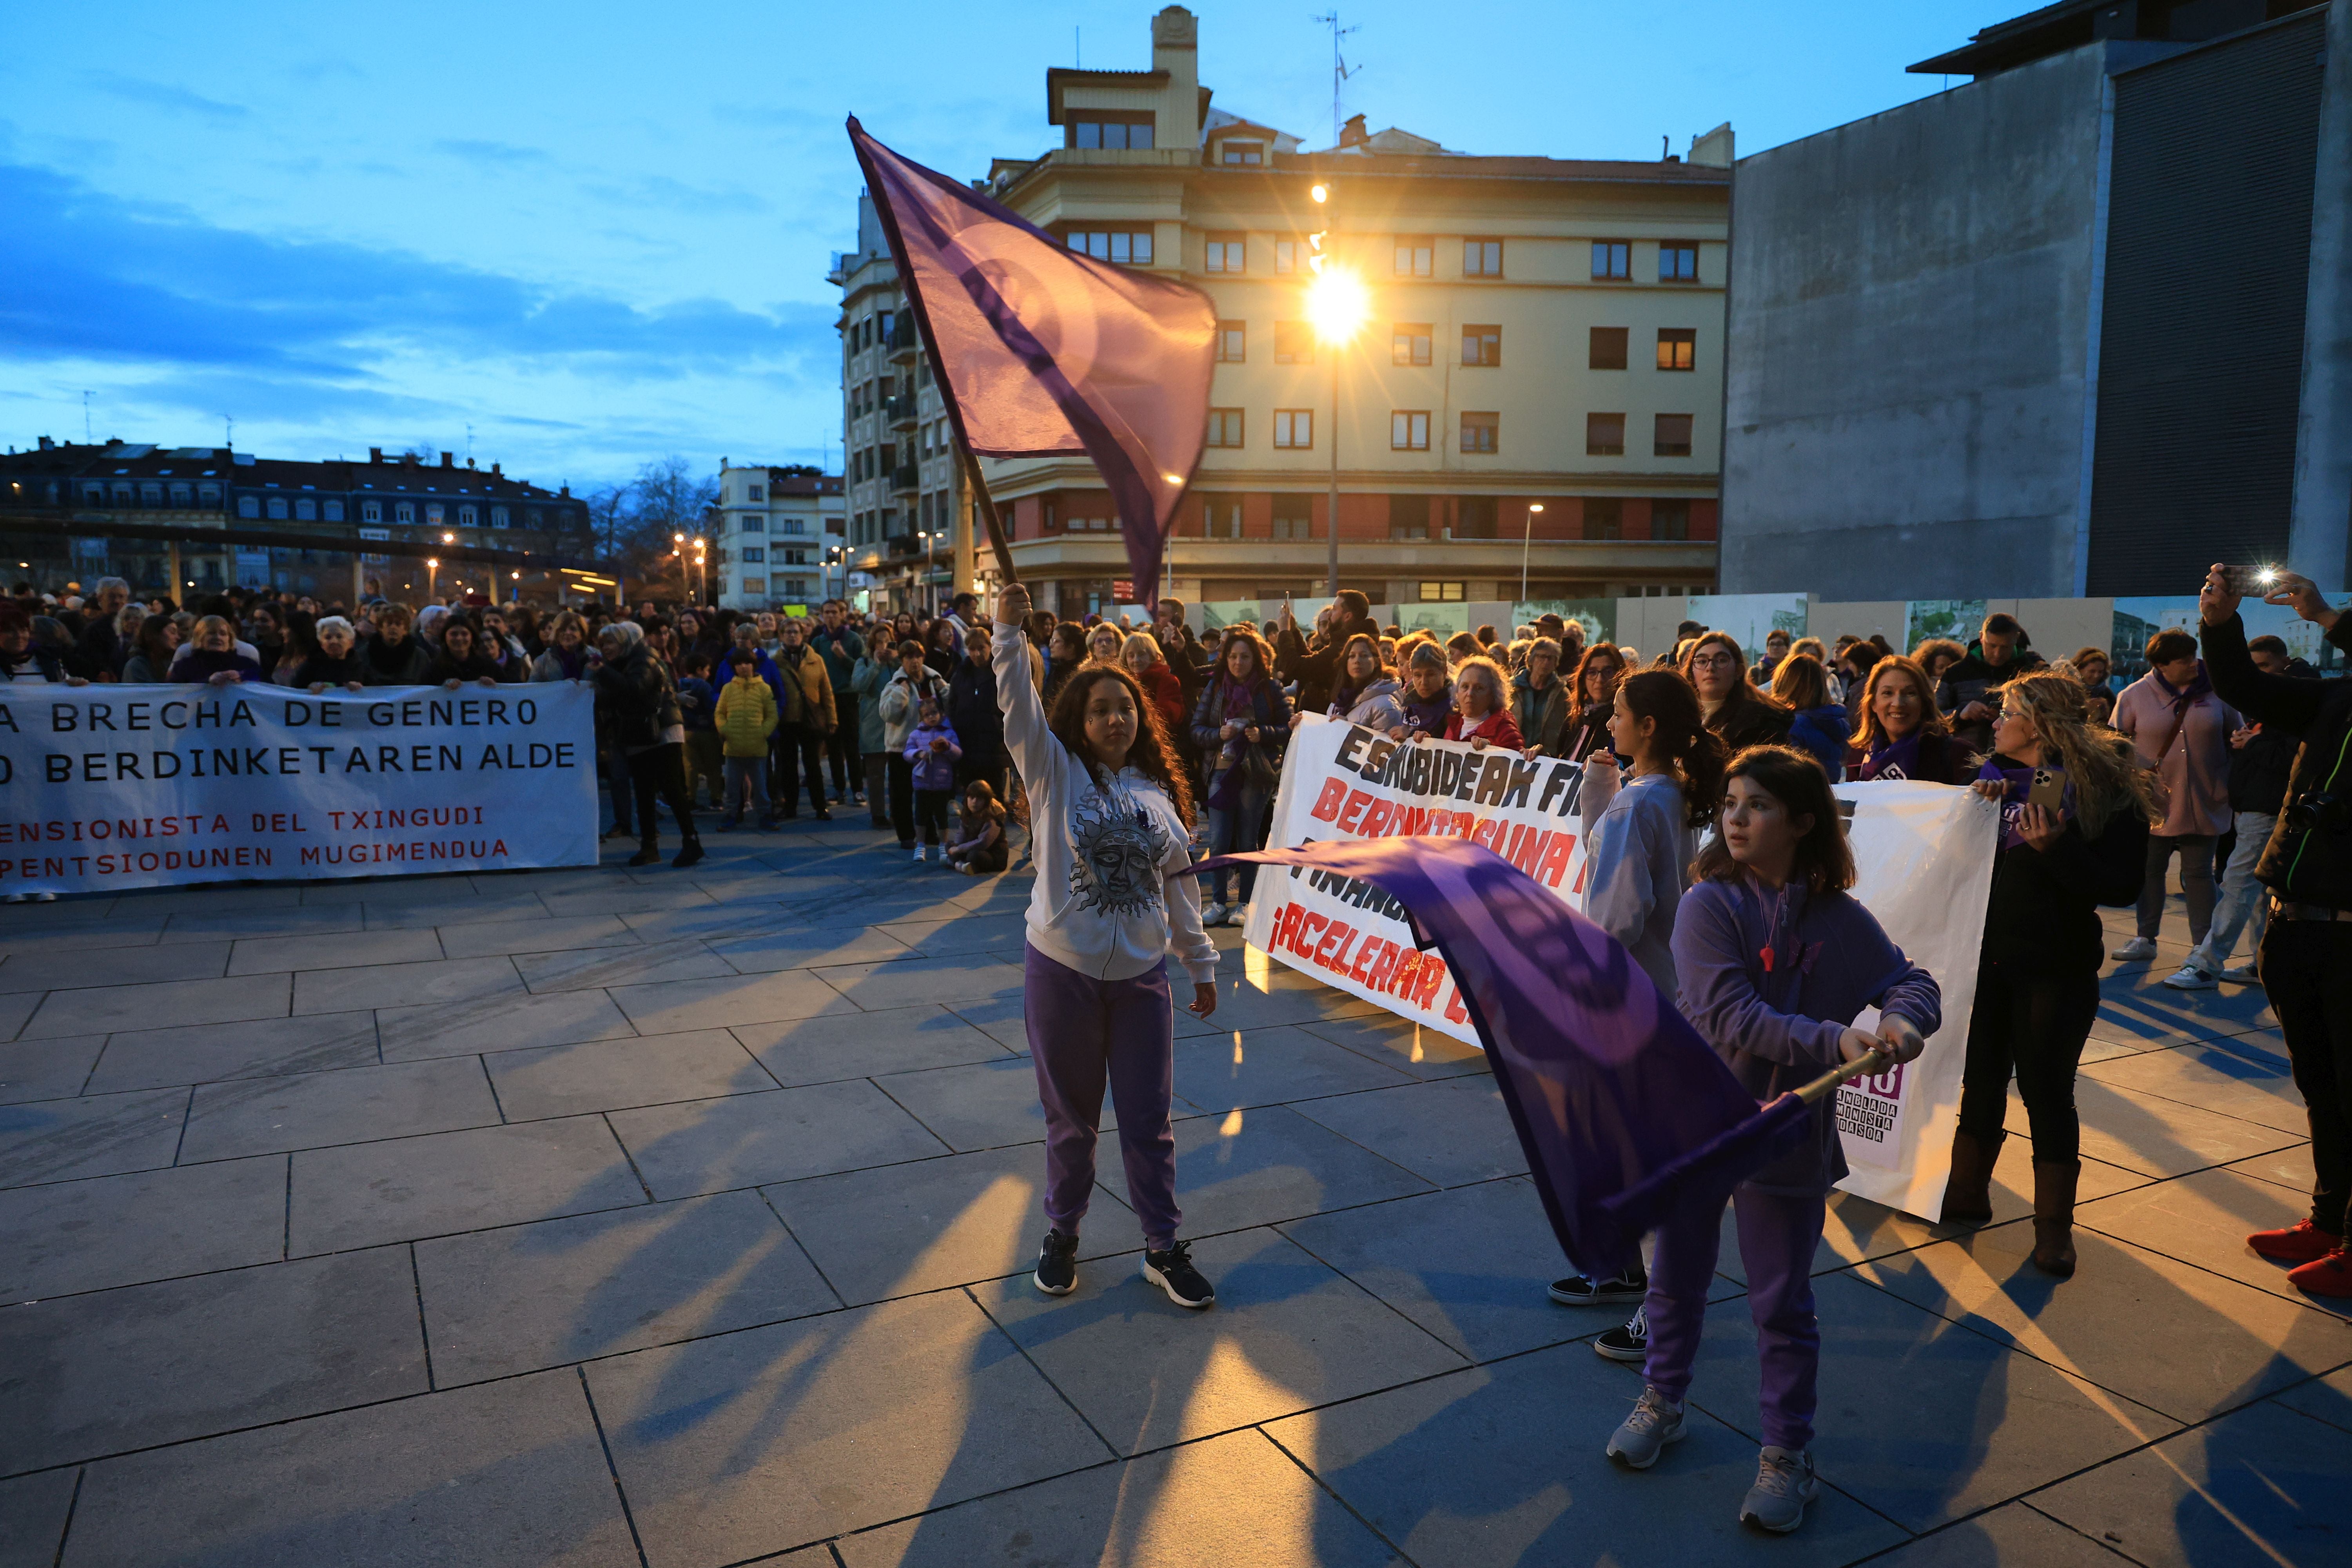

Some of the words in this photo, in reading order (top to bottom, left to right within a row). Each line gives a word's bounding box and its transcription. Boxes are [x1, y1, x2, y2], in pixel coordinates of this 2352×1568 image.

[52, 700, 256, 732] BRECHA
[285, 700, 342, 727] DE
[367, 699, 537, 726] GENERO
[45, 745, 462, 783] BERDINKETAREN
[479, 742, 575, 770] ALDE
[1335, 725, 1541, 808] ESKUBIDEAK
[0, 815, 230, 843] ENSIONISTA
[252, 813, 306, 832] DEL
[328, 806, 484, 830] TXINGUDI
[0, 847, 271, 878] PENTSIODUNEN
[301, 839, 509, 864] MUGIMENDUA
[1836, 1117, 1884, 1143] DASOA
